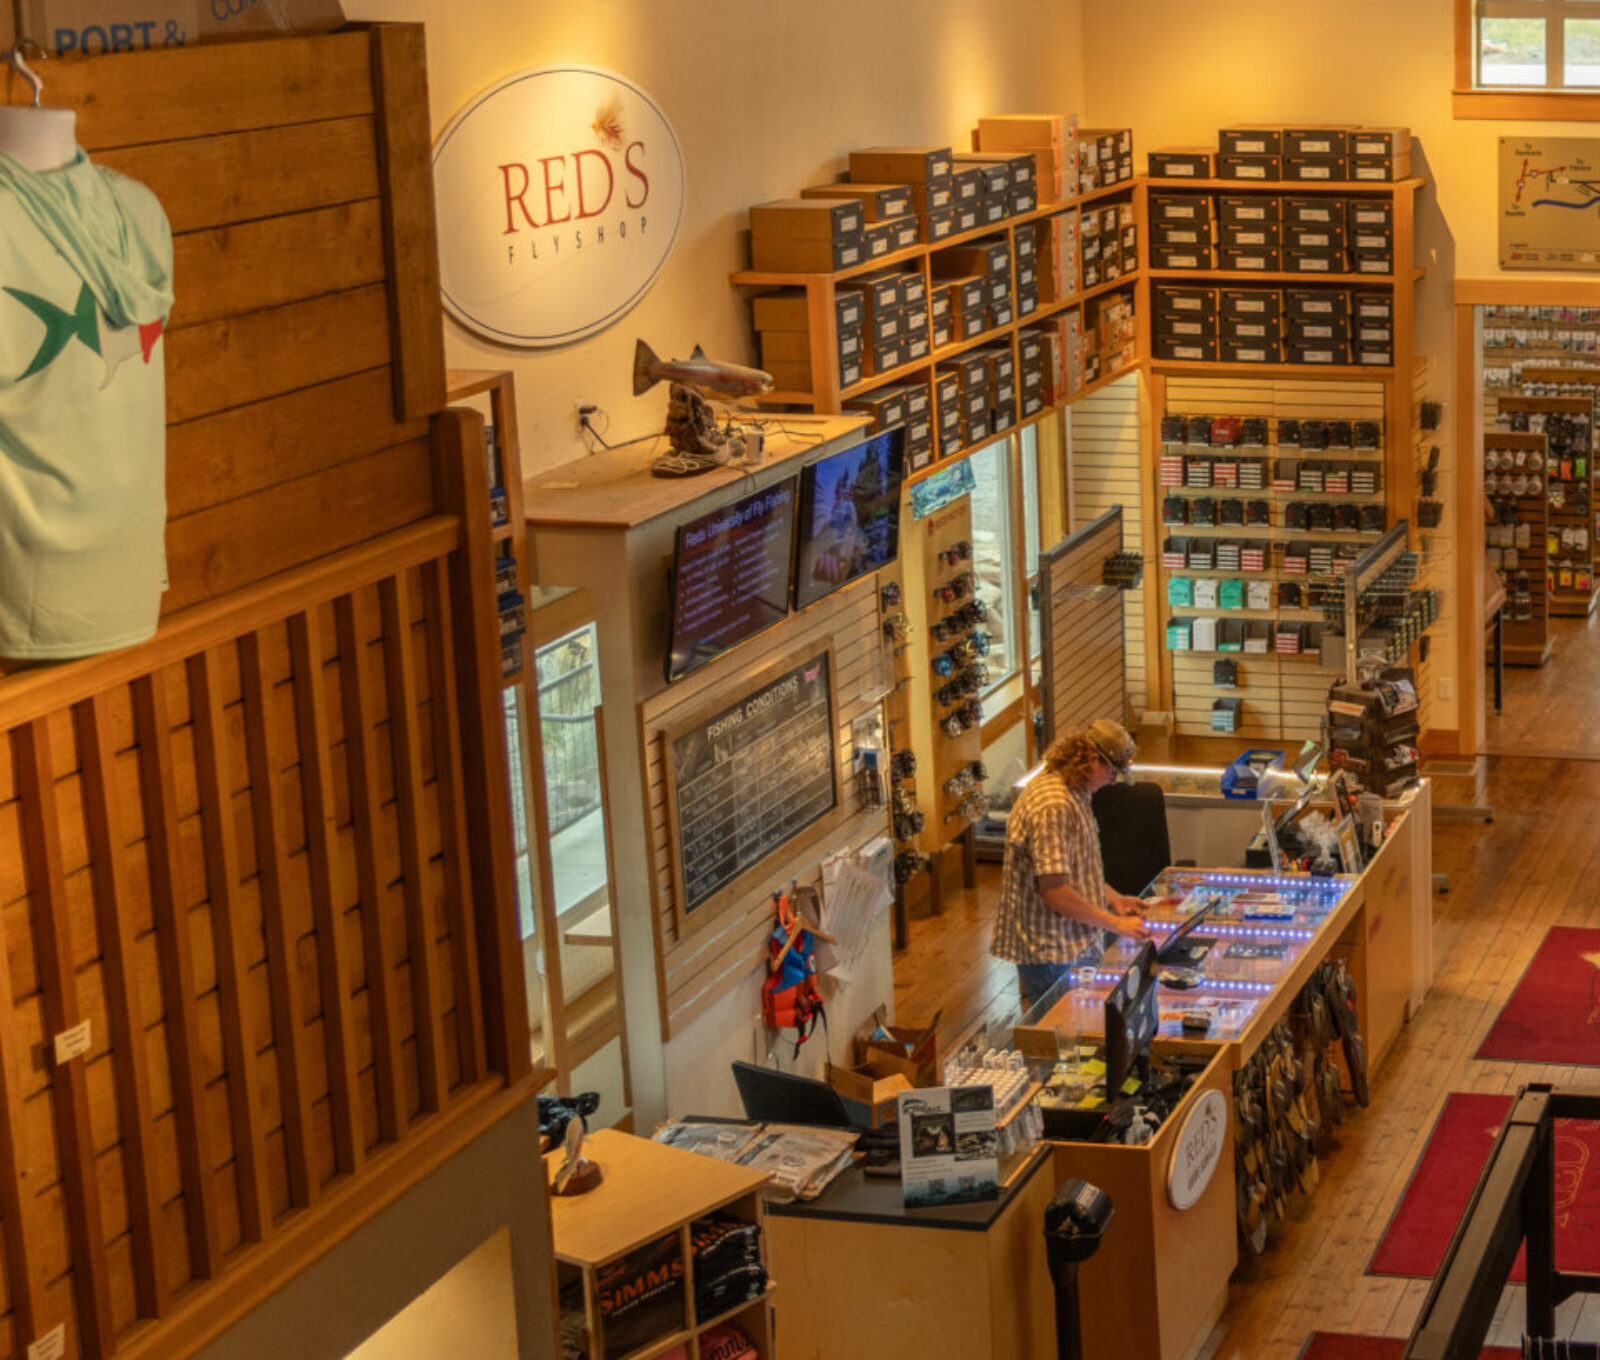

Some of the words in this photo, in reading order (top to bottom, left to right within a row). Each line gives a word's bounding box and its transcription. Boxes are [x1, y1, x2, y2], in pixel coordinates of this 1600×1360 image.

[707, 707, 744, 742] FISHING
[745, 675, 799, 718] CONDITIONS
[600, 1255, 685, 1315] SIMMS
